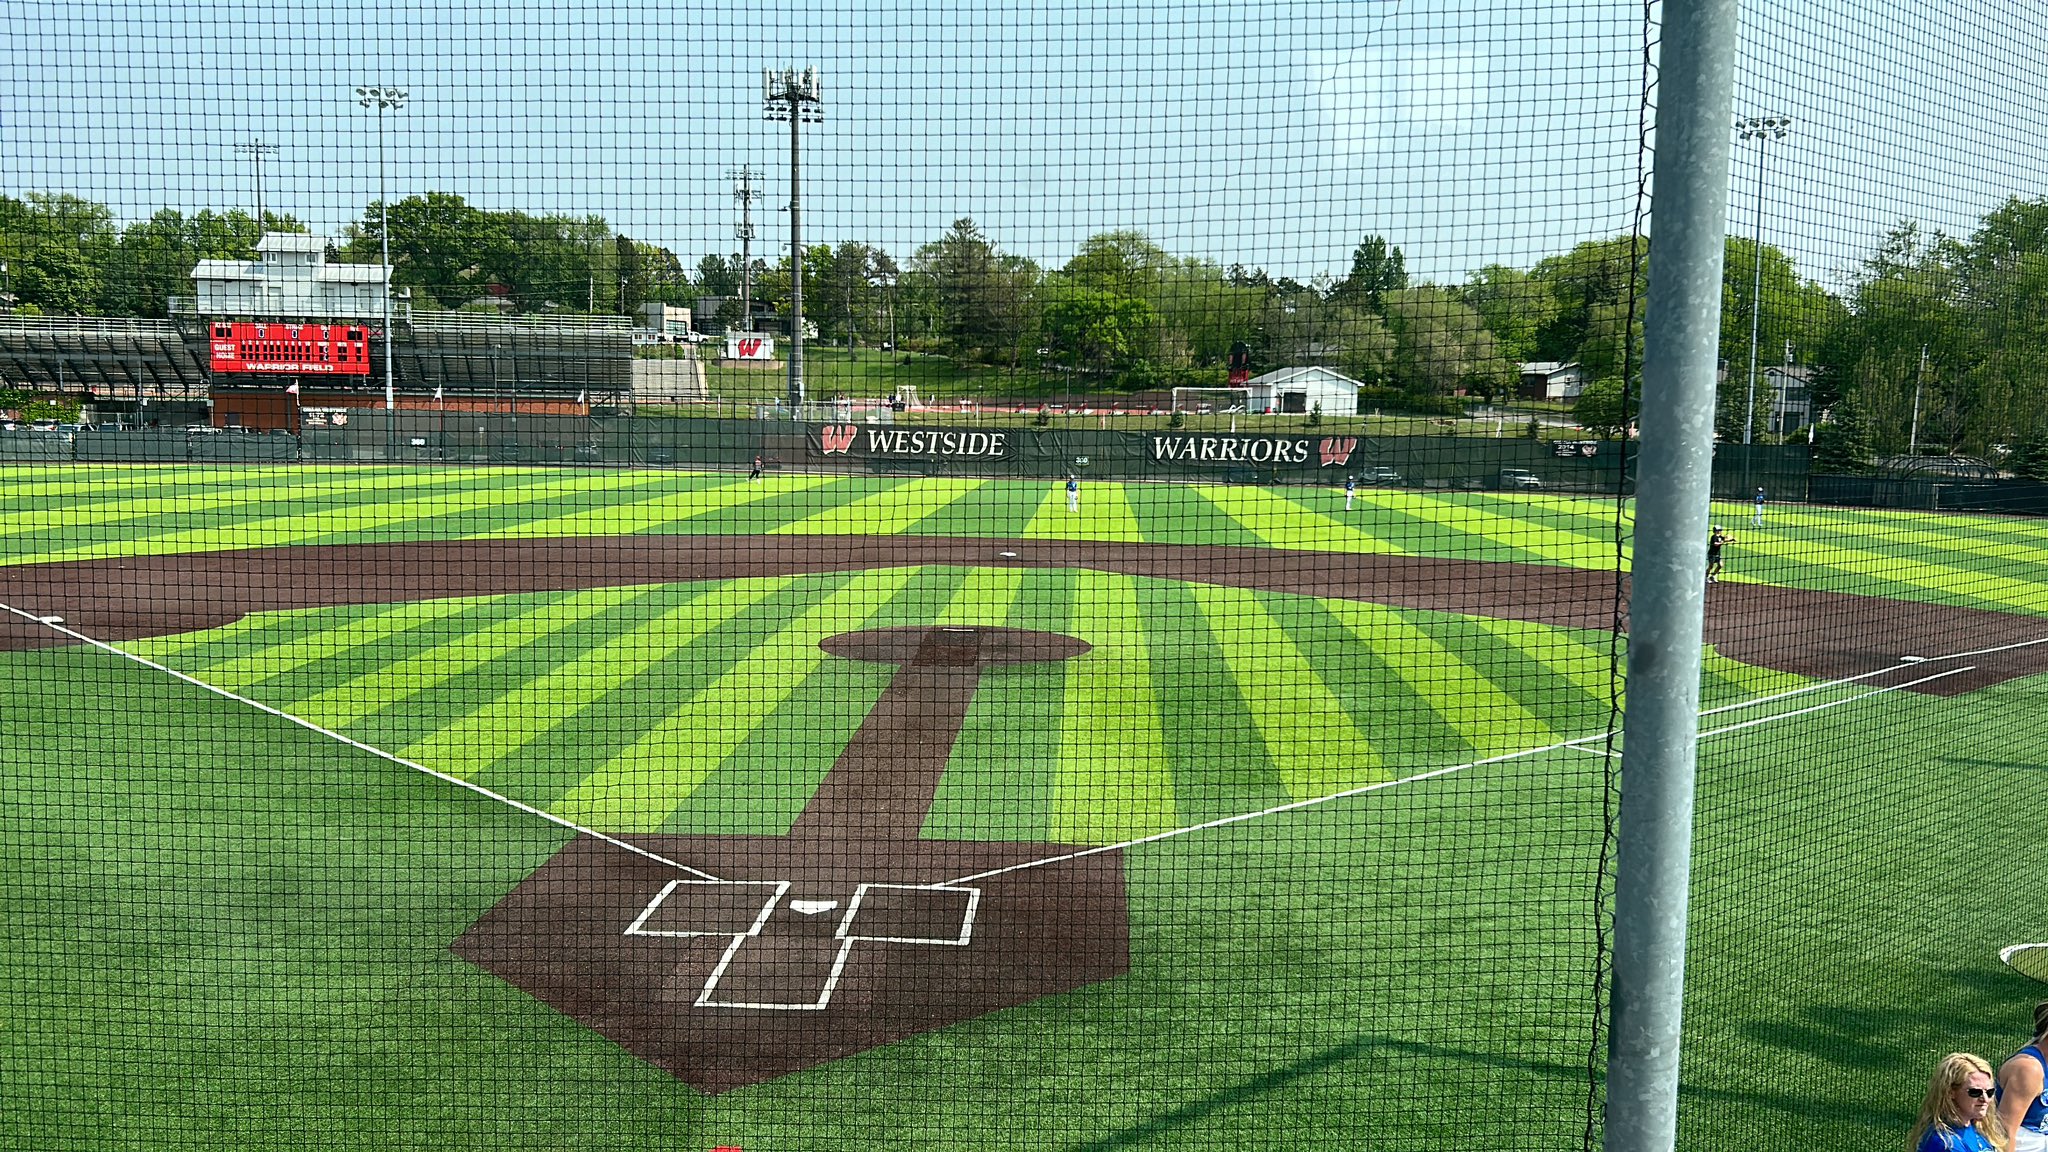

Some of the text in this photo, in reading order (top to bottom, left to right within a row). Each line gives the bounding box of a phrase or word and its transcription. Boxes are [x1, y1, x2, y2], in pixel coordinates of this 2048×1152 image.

[738, 338, 762, 357] W
[822, 425, 1005, 456] W WESTSIDE
[1153, 436, 1357, 468] WARRIORS W
